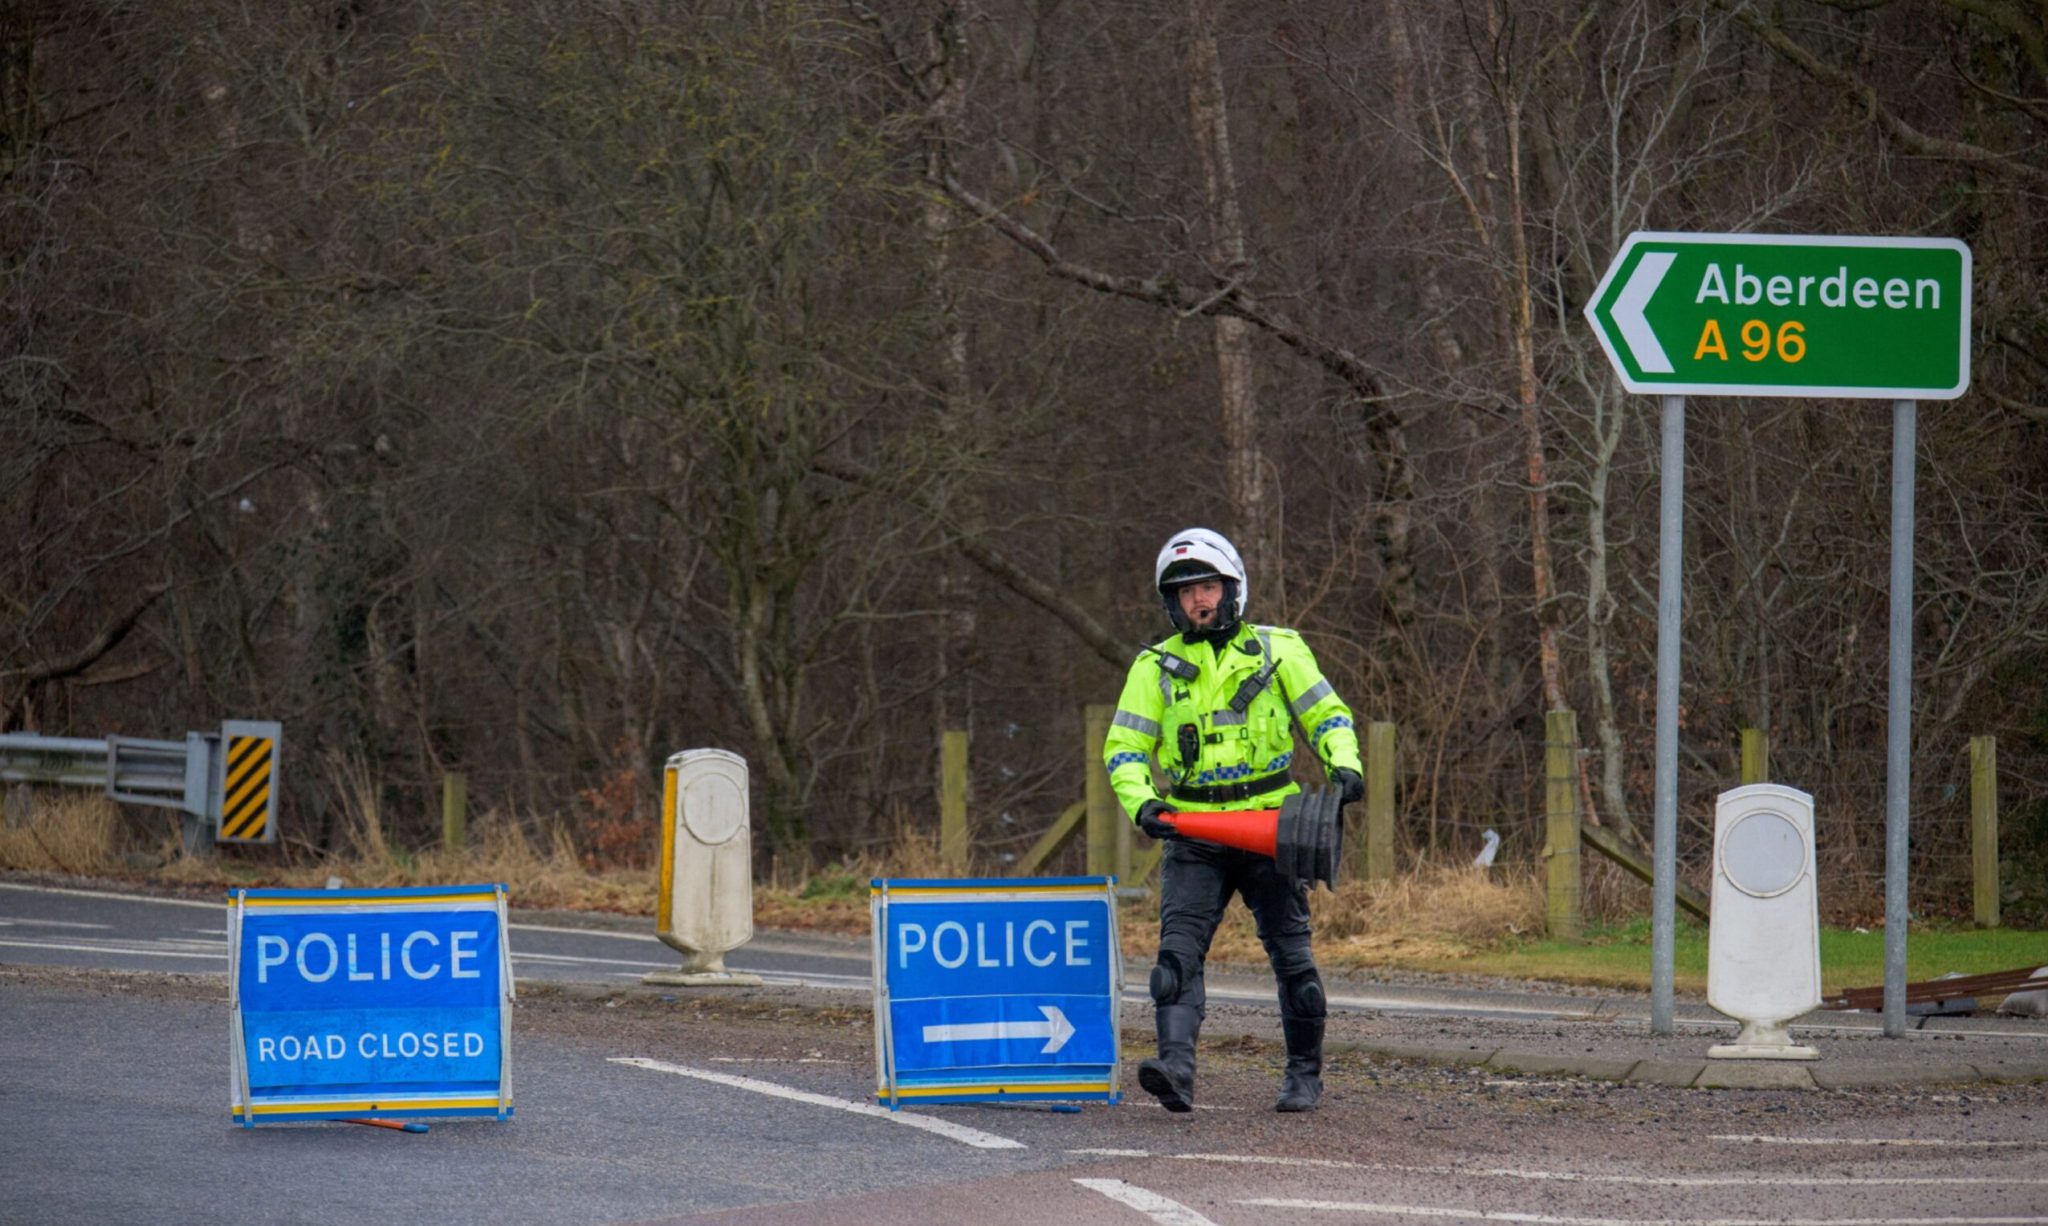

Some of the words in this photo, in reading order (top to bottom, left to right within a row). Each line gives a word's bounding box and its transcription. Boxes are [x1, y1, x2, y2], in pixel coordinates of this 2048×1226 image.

[1695, 263, 1941, 309] Aberdeen
[257, 930, 481, 983] POLICE
[898, 919, 1092, 969] POLICE
[258, 1035, 346, 1062] ROAD
[358, 1032, 484, 1058] CLOSED
